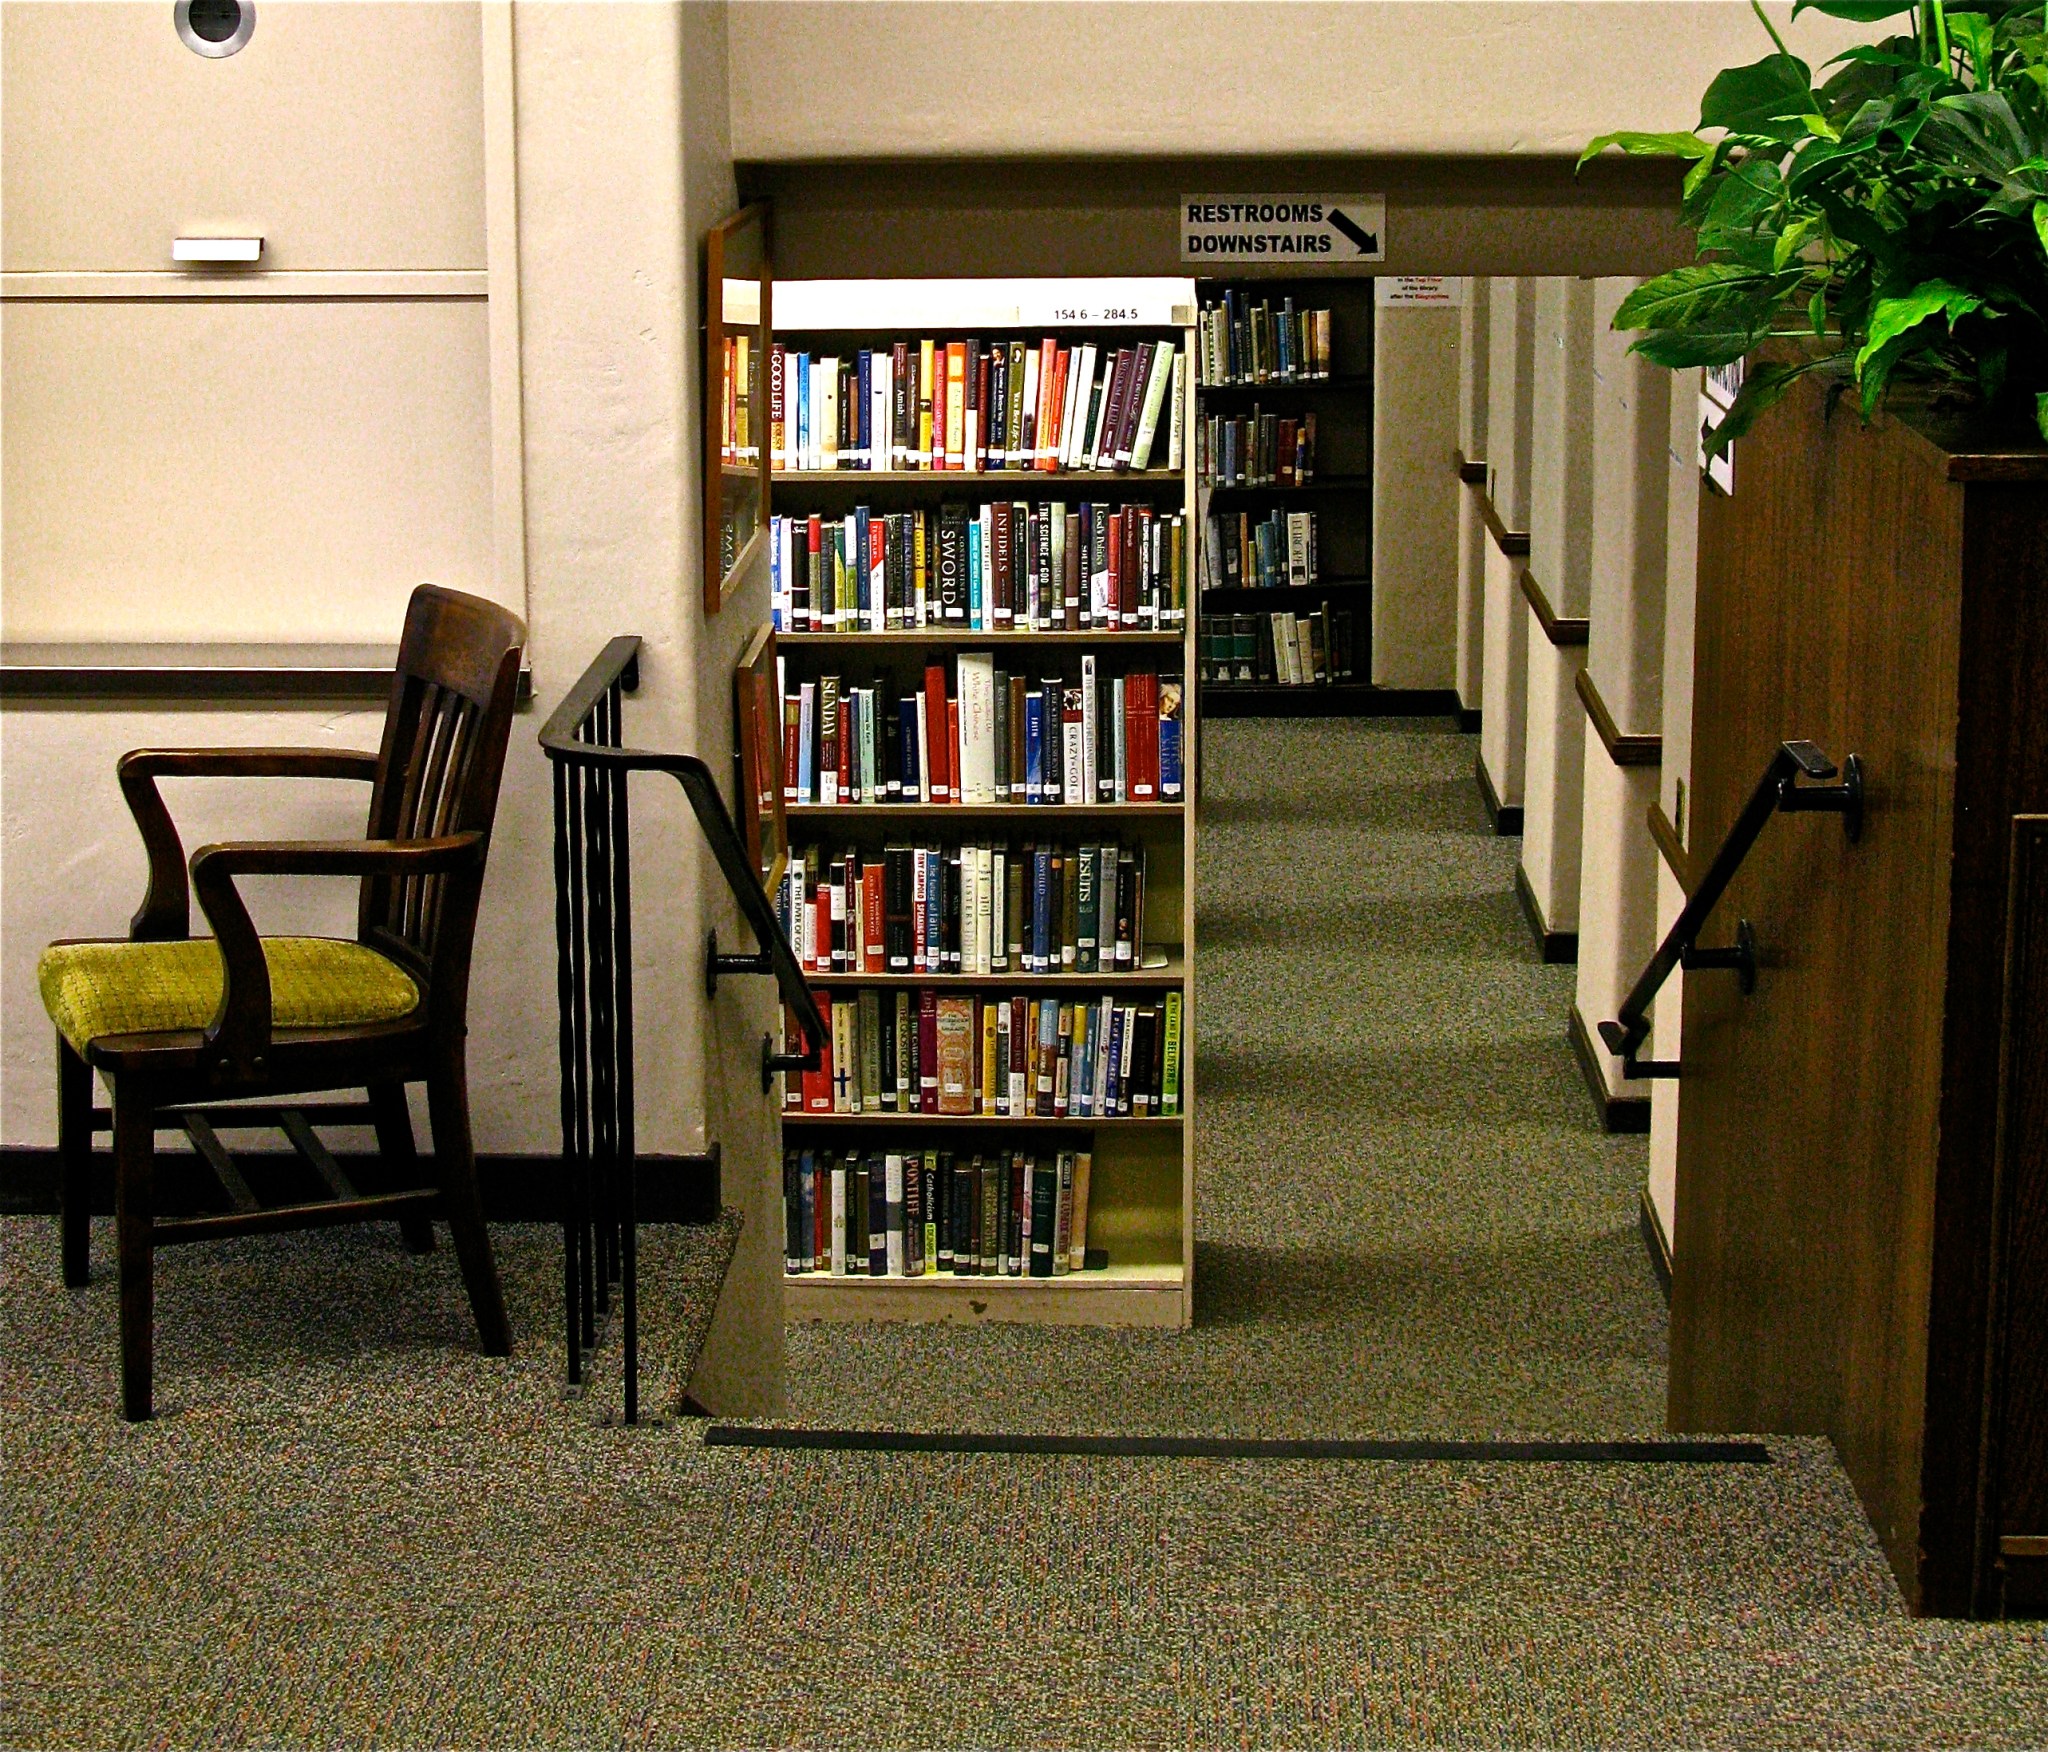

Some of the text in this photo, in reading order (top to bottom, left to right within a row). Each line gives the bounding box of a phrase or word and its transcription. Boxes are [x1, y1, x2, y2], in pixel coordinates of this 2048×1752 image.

[1188, 204, 1323, 223] RESTROOMS
[1188, 234, 1332, 253] DOWNSTAIRS
[1055, 308, 1088, 320] 154.6
[1103, 308, 1138, 320] 284.5
[771, 354, 783, 419] GOOD LIFE
[997, 367, 1005, 389] Become
[1114, 358, 1131, 396] WISDOM
[896, 389, 905, 415] Amish
[1012, 409, 1020, 423] Best
[1010, 424, 1020, 439] Life
[1039, 508, 1049, 522] THE
[997, 513, 1008, 572] INFIDELS
[1039, 524, 1049, 557] SCIENCE
[1095, 510, 1105, 566] God's Politics
[941, 529, 956, 605] SWORD
[958, 535, 966, 599] CONSTANTINE'S
[1040, 567, 1049, 584] GOD
[821, 681, 836, 738] SUNDAY
[1068, 726, 1079, 788] CRAZY GO
[917, 852, 925, 900] TONY CAMPOLO
[929, 864, 939, 877] the
[1078, 853, 1092, 902] JESUITS
[929, 879, 938, 902] future
[965, 878, 973, 926] SISTERS
[794, 885, 802, 955] THE RIVER OF GOD
[916, 903, 925, 944] SPEAKING MY
[929, 913, 939, 938] faith
[900, 1007, 908, 1022] THE
[900, 1023, 908, 1058] GNOSTIC
[1166, 1041, 1177, 1084] BELIEVERS
[906, 1159, 920, 1215] PONTIFF
[926, 1172, 936, 1220] Catholicism
